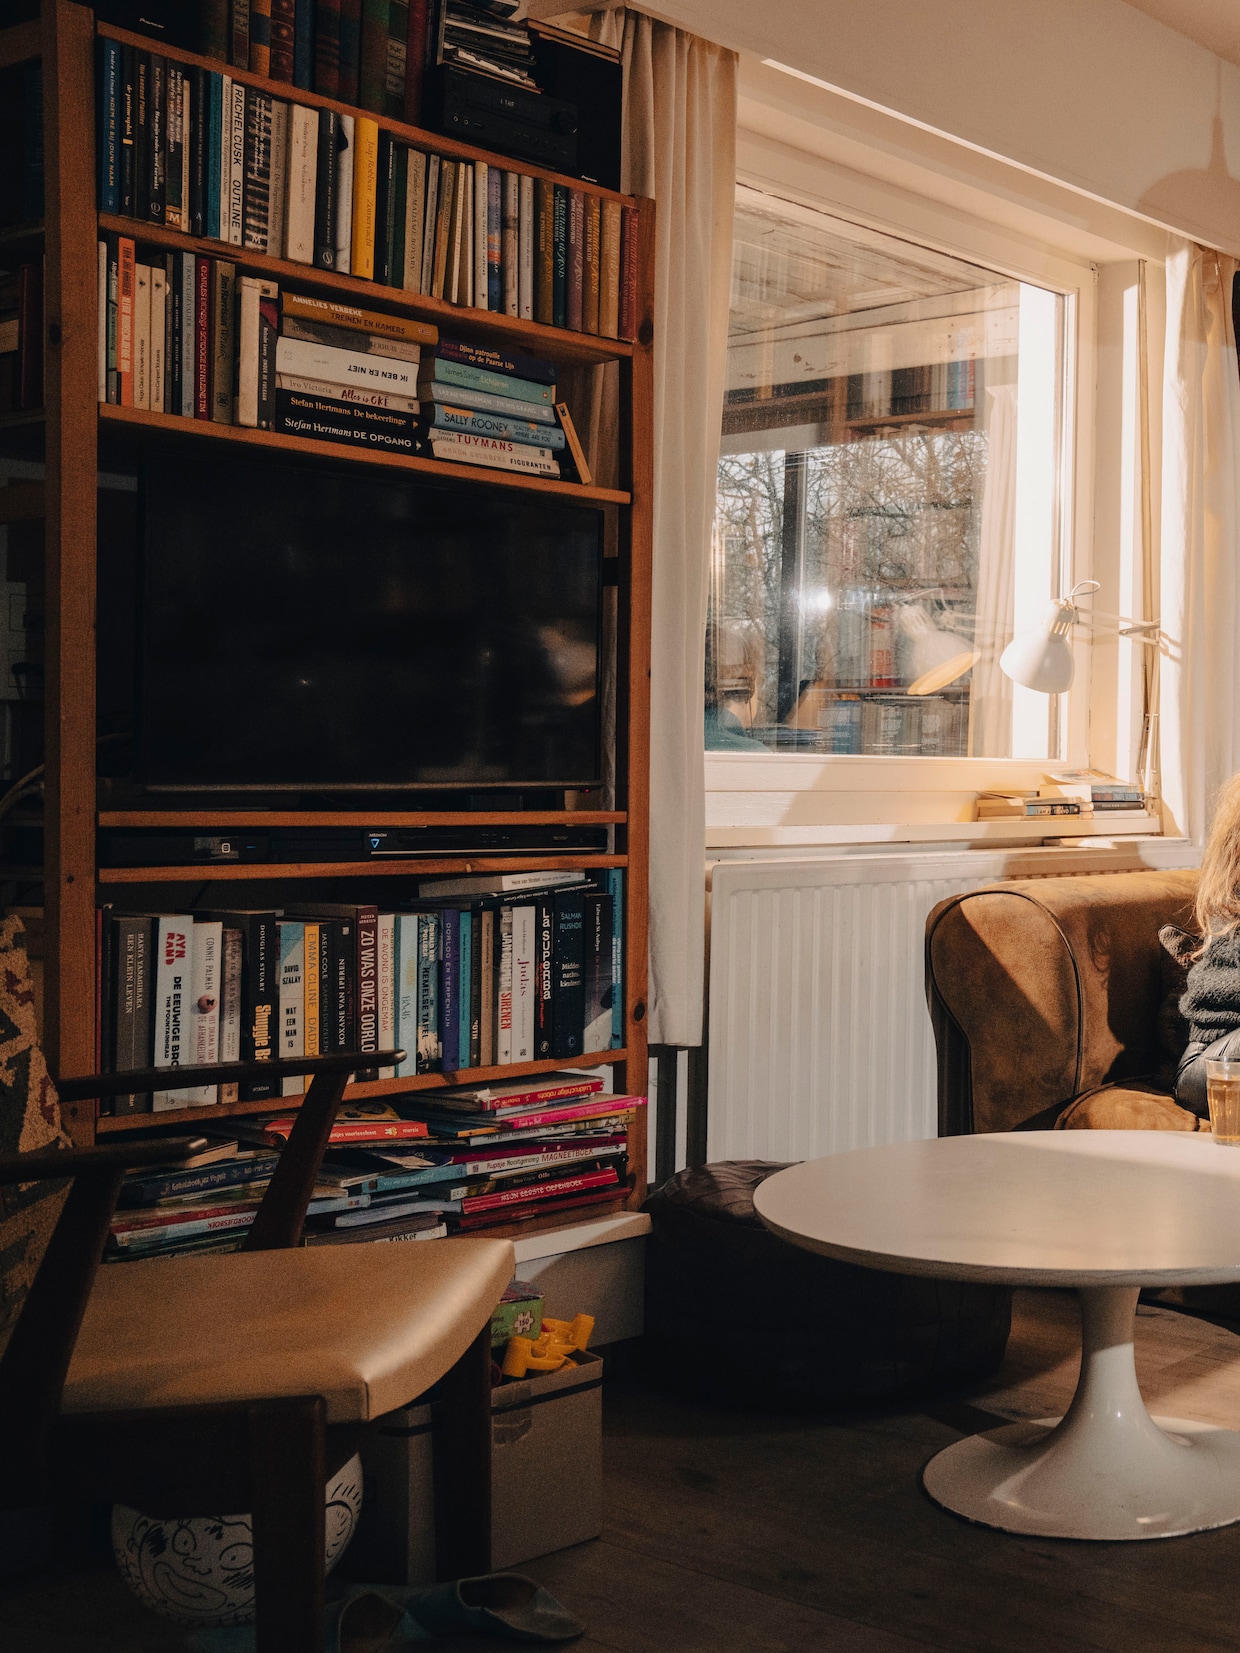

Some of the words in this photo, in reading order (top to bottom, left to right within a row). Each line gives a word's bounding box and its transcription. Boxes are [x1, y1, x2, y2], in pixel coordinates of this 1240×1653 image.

[234, 89, 243, 132] RACHEL
[233, 135, 242, 166] CUSK
[366, 139, 375, 159] Jaap
[232, 179, 241, 228] OUTLINE
[365, 199, 374, 246] Zomervacht
[292, 296, 328, 310] ANNELIES
[330, 303, 363, 317] VERBEKE
[330, 313, 362, 325] TREINEN
[375, 321, 406, 334] KAMERS
[459, 344, 474, 353] Djinn
[475, 347, 501, 359] patrouille
[486, 357, 502, 368] Paarse
[504, 362, 515, 371] Lijn
[347, 365, 367, 374] NIET
[369, 368, 379, 376] ER
[381, 371, 398, 379] BEN
[290, 396, 313, 409] Stefan
[315, 401, 351, 416] Hertmans
[354, 409, 366, 417] De
[367, 410, 406, 426] bekeerlinge
[444, 413, 468, 426] SALLY
[471, 417, 508, 432] ROONEY
[285, 417, 311, 432] Stefan
[313, 423, 352, 438] Hertmans
[353, 431, 367, 439] DE
[369, 433, 412, 448] OPGANG
[456, 433, 513, 452] TUYMANS
[175, 934, 185, 958] AYN
[361, 931, 375, 946] ZO
[382, 928, 389, 941] DE
[501, 933, 511, 951] JAN
[165, 932, 174, 965] RAND
[206, 937, 214, 961] CONNIE
[307, 933, 317, 969] EMMA
[381, 944, 389, 972] AVOND
[126, 954, 134, 981] KLEIN
[284, 965, 299, 973] DAVID
[361, 948, 375, 977] WAS
[445, 962, 451, 974] EN
[501, 953, 511, 987] CREMER
[136, 960, 144, 1008] YANAGIHARA
[173, 976, 182, 990] DE
[205, 965, 213, 990] PALMEN
[283, 976, 301, 985] SZALAY
[381, 975, 389, 985] IS
[421, 967, 430, 1010] HEMELSE
[517, 958, 530, 997] Judas
[125, 984, 133, 1013] LEVEN
[307, 973, 317, 1009] CLINE
[361, 980, 375, 1010] ONZE
[172, 993, 181, 1042] EEUWIGE
[286, 1007, 297, 1015] WAT
[380, 988, 389, 1032] ONGEMAK
[500, 992, 511, 1029] SIRENEN
[252, 1005, 271, 1047] Shuggie
[286, 1029, 297, 1037] MAN
[307, 1017, 317, 1057] DADDY
[360, 1014, 375, 1052] OORLO
[421, 1012, 430, 1040] TAFEL
[171, 1045, 179, 1066] BRO
[542, 1148, 594, 1162] MAGNEETBOEK
[520, 1187, 544, 1199] EERSTE
[545, 1179, 583, 1193] OEFENBOEK
